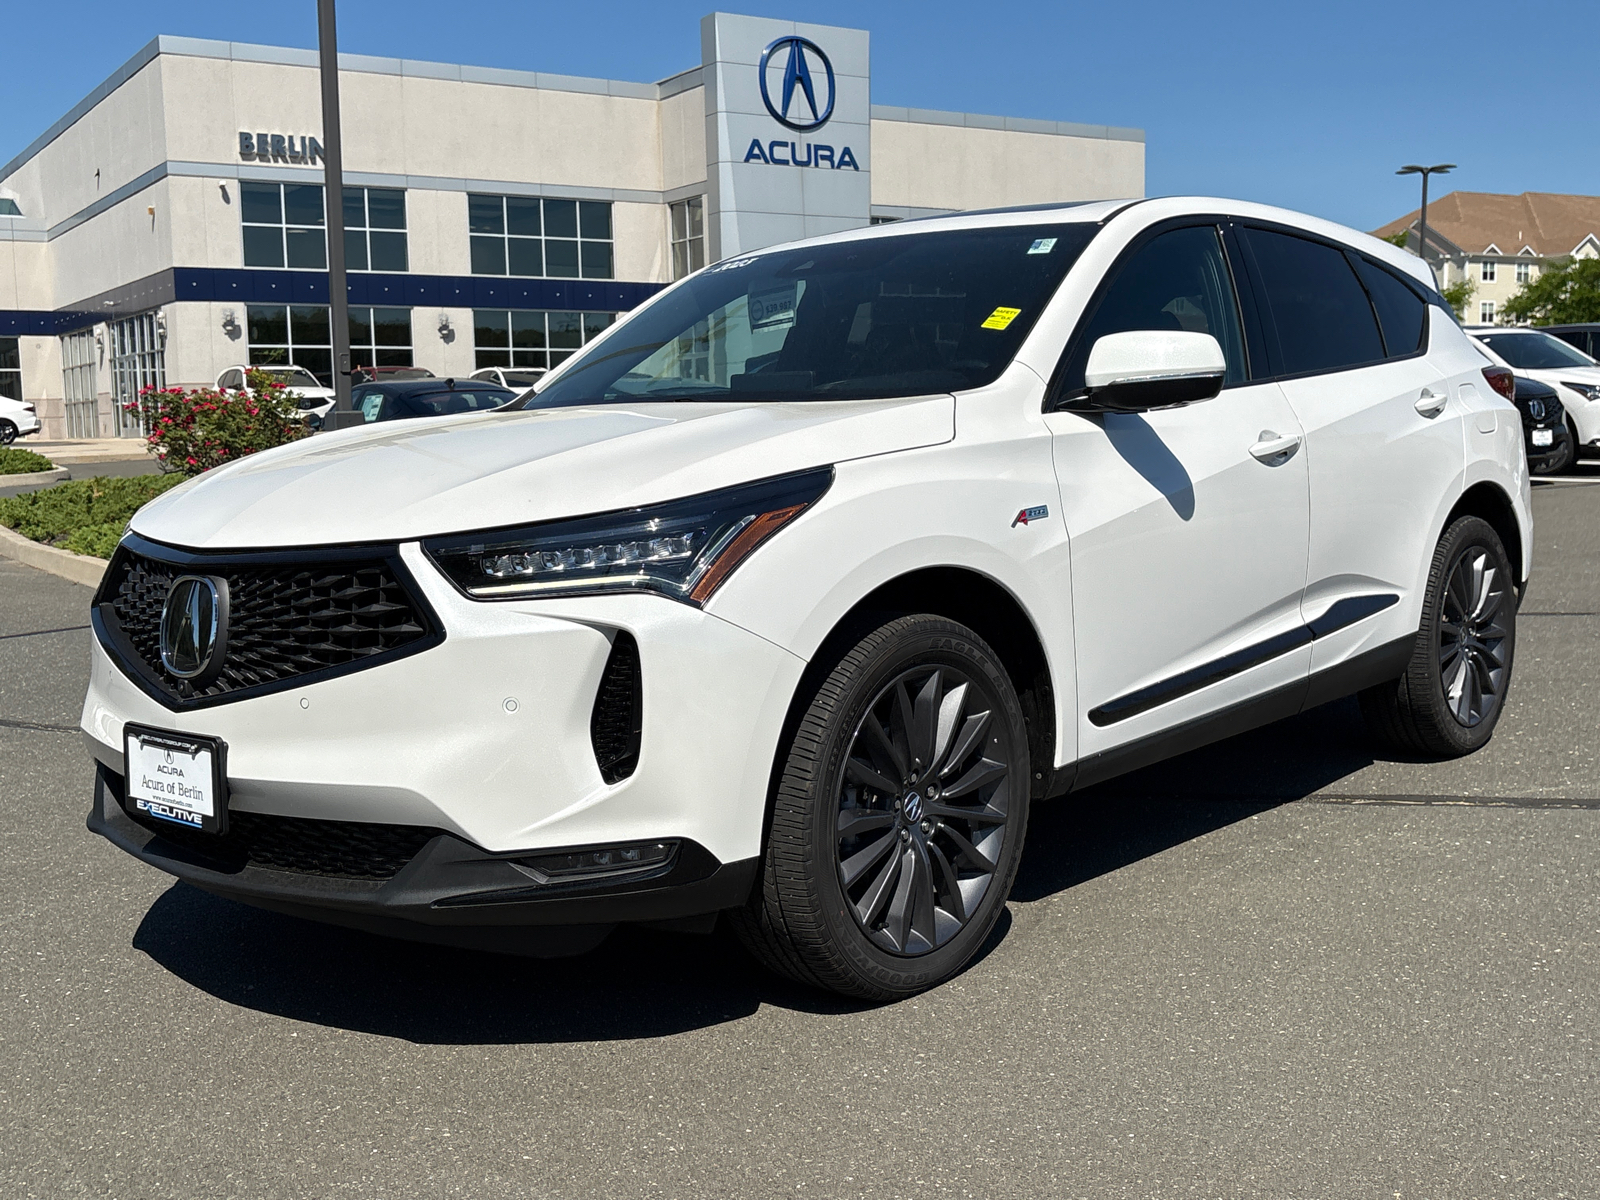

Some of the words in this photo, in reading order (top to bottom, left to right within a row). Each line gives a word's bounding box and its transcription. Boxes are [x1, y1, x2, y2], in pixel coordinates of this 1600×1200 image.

[239, 132, 324, 159] BERLIN
[744, 138, 860, 172] ACURA
[928, 633, 988, 675] EAGLE
[157, 764, 185, 778] ACURA
[141, 774, 165, 792] Acura
[166, 782, 177, 795] of
[178, 784, 204, 801] Berlin
[136, 799, 203, 825] EXECUTIVE
